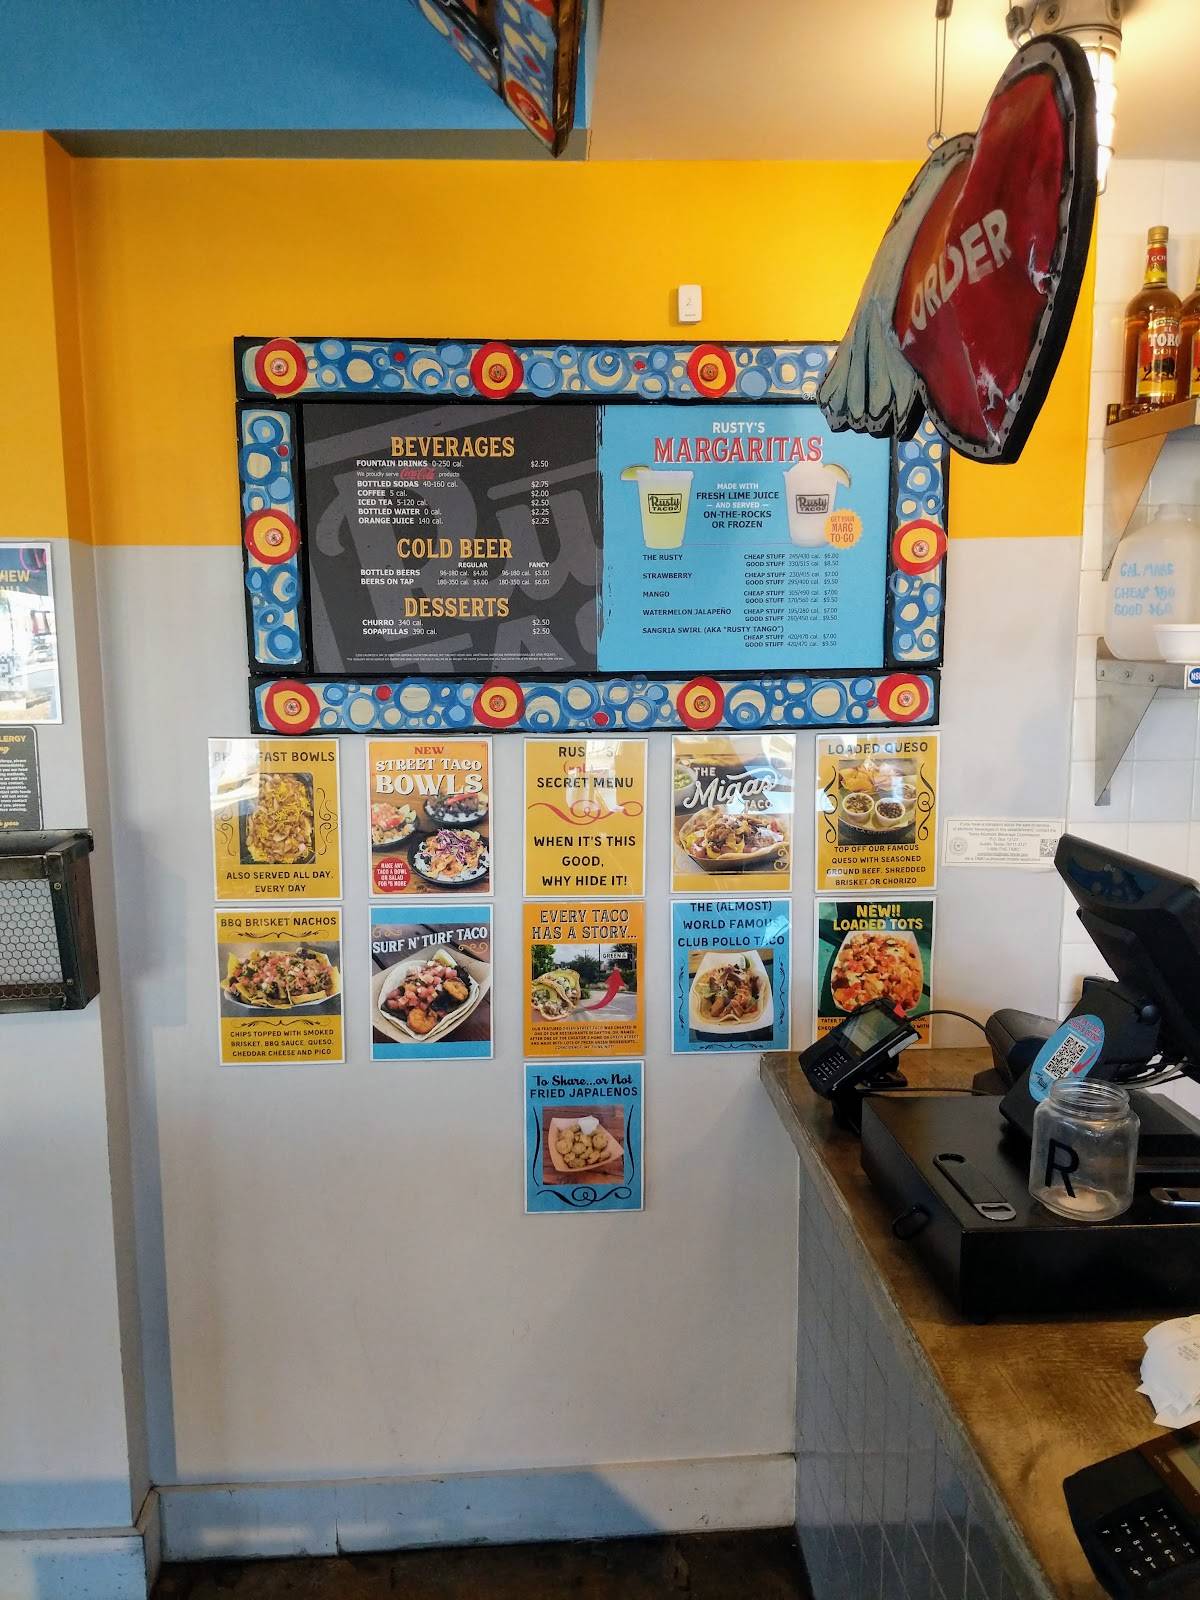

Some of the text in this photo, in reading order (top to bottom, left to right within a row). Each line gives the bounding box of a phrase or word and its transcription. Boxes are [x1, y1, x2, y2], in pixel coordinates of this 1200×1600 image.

[912, 209, 1011, 330] ORDER
[712, 422, 765, 434] RUSTY'S
[391, 436, 515, 457] BEVERAGES
[654, 437, 823, 464] MARGARITAS
[530, 460, 548, 468] $2.50
[531, 480, 548, 488] $2.75
[651, 496, 679, 507] Rusty
[798, 496, 827, 507] Rusty
[531, 508, 549, 516] $2.25
[832, 523, 853, 532] MARG
[831, 534, 854, 543] TO-GO
[397, 538, 513, 558] COLD BEER
[404, 597, 509, 617] DESSERTS
[828, 742, 928, 754] LOADED QUESO
[292, 752, 335, 761] BOWLS
[376, 758, 482, 771] STREET TACO
[693, 767, 716, 776] THE
[376, 774, 483, 796] BOWLS
[537, 778, 634, 788] SECRET MENU
[534, 836, 635, 846] WHEN IT'S THIS
[562, 856, 604, 867] GOOD,
[542, 876, 627, 886] WHY HIDE IT!
[690, 901, 772, 912] THE (ALMOST)
[857, 905, 900, 917] NEW!!
[540, 909, 628, 923] EVERY TACO
[246, 918, 289, 926] BRISKET
[684, 920, 725, 929] WORLD
[833, 919, 923, 930] LOADED TOTS
[532, 926, 637, 939] HAS A STORY...
[373, 927, 487, 953] SURF N' TURF TACO
[678, 938, 708, 946] CLUB
[713, 937, 750, 946] POLLO
[533, 1076, 549, 1086] To
[611, 1074, 632, 1084] Not
[530, 1087, 637, 1098] FRIED JAPALENOS
[1045, 1139, 1079, 1198] R
